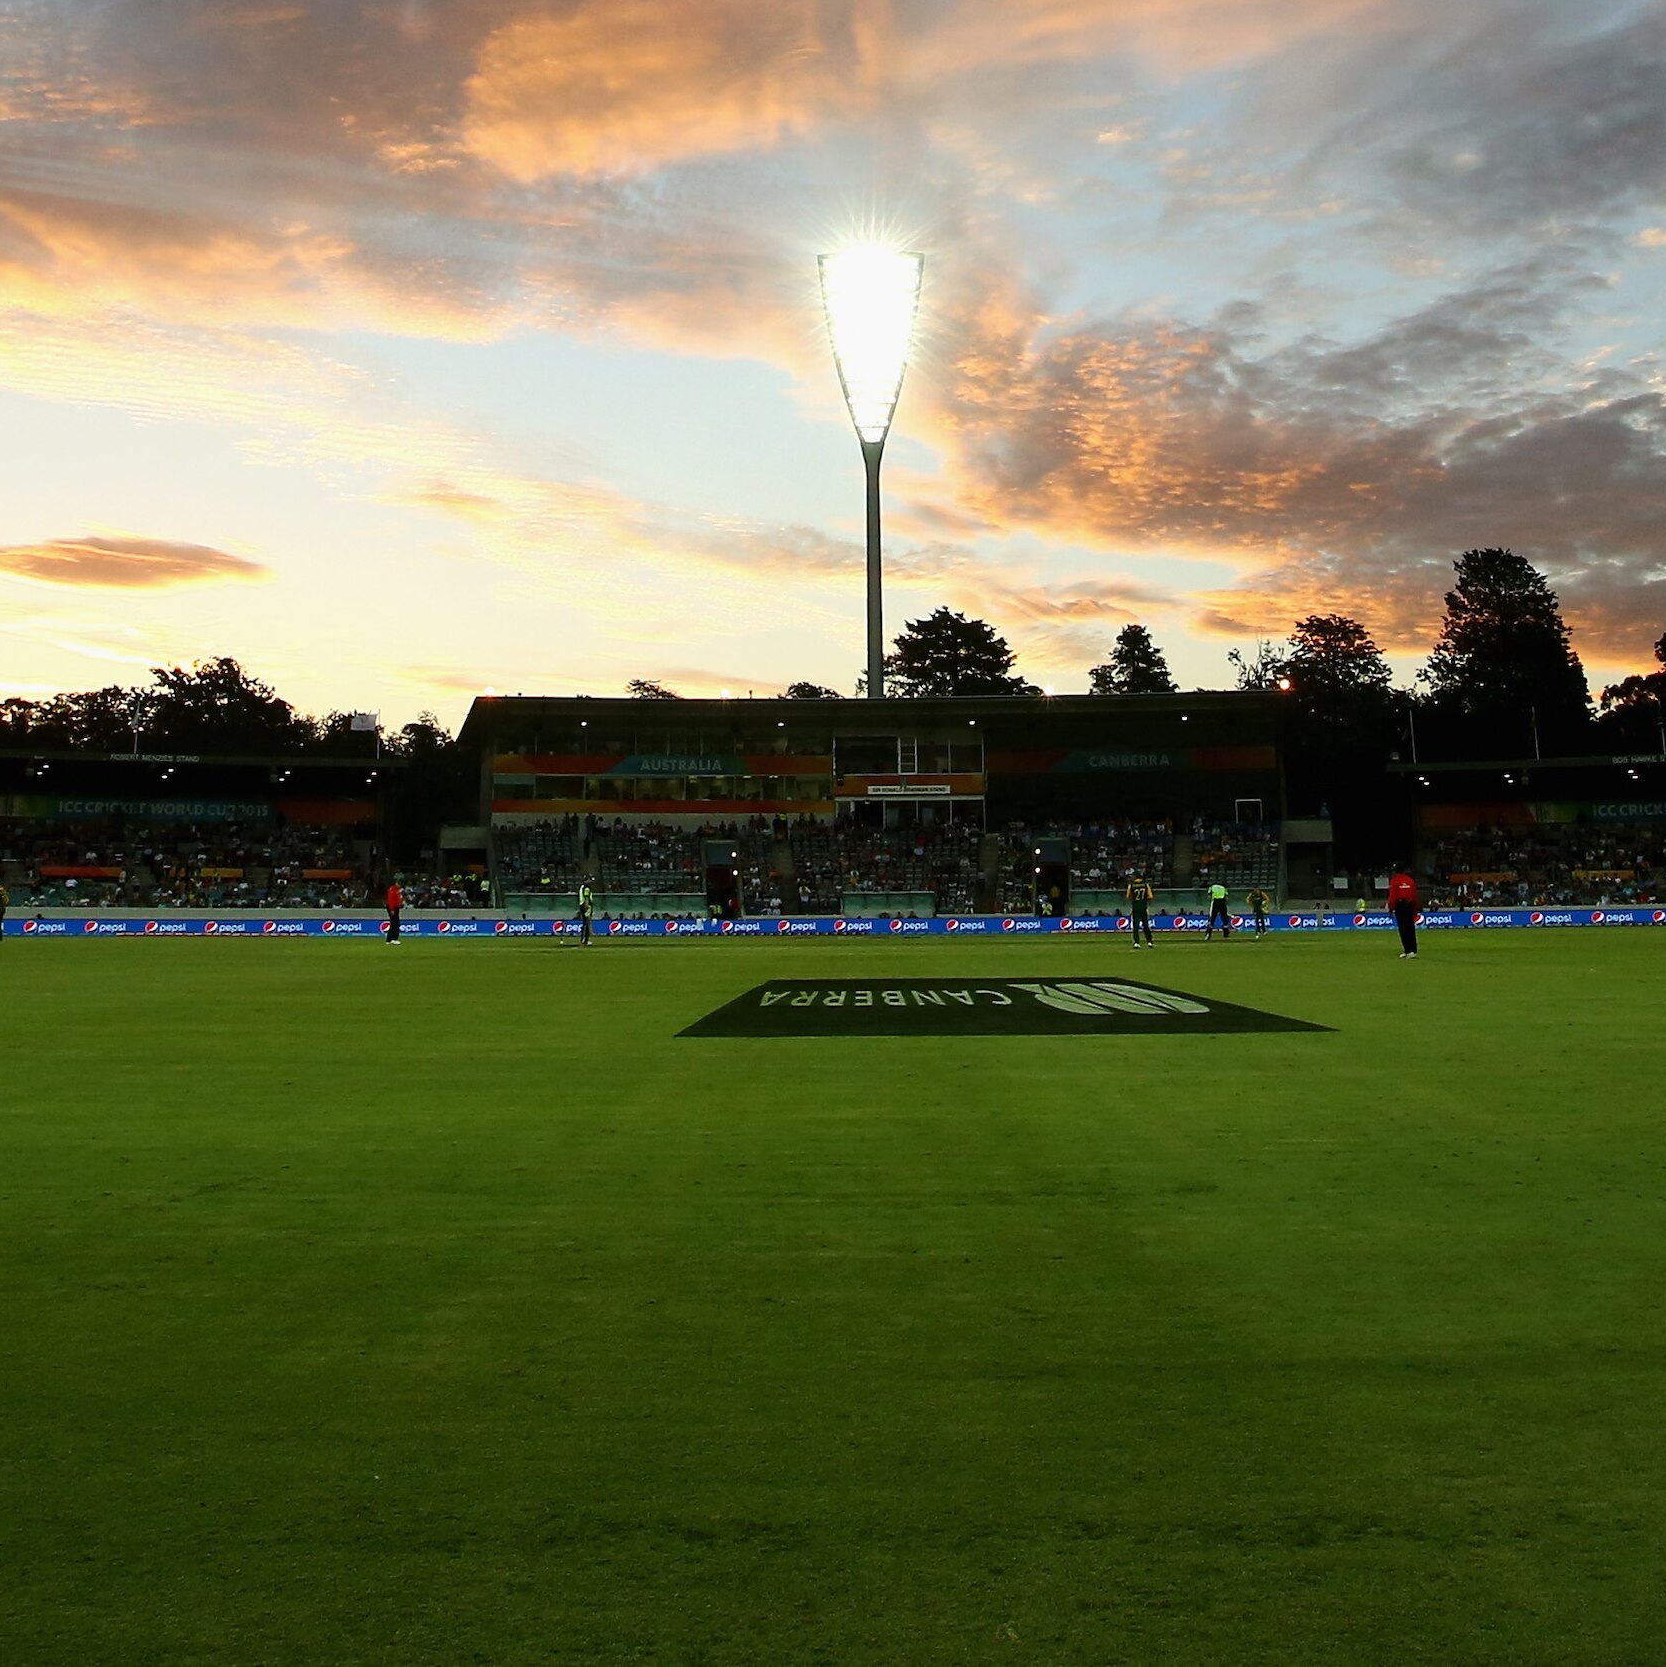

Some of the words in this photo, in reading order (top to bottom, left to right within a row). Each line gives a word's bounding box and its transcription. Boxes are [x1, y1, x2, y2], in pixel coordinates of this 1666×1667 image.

[640, 759, 722, 771] AUSTRALIA
[1089, 754, 1170, 767] CANBERRA
[58, 800, 83, 813] ICC
[150, 802, 205, 815] WORLD
[1593, 804, 1617, 817] ICC
[1134, 888, 1146, 901] 27
[1425, 915, 1452, 925] pepsi
[1485, 914, 1511, 924] pepsi
[1544, 914, 1572, 924] pepsi
[1605, 913, 1633, 923] pepsi
[37, 923, 66, 933] pepsi
[98, 923, 126, 933] pepsi
[158, 923, 186, 933] pepsi
[218, 923, 245, 933] pepsi
[277, 923, 304, 933] pepsi
[335, 923, 362, 933] pepsi
[399, 923, 420, 933] epsi
[451, 923, 477, 933] pepsi
[508, 923, 534, 933] pepsi
[622, 923, 648, 933] pepsi
[734, 922, 760, 932] pepsi
[791, 922, 816, 932] pepsi
[847, 921, 873, 931] pepsi
[903, 921, 929, 931] pepsi
[960, 921, 985, 931] pepsi
[1016, 920, 1041, 930] pepsi
[1072, 920, 1099, 930] pepsi
[759, 989, 1013, 1007] CANBERRA
